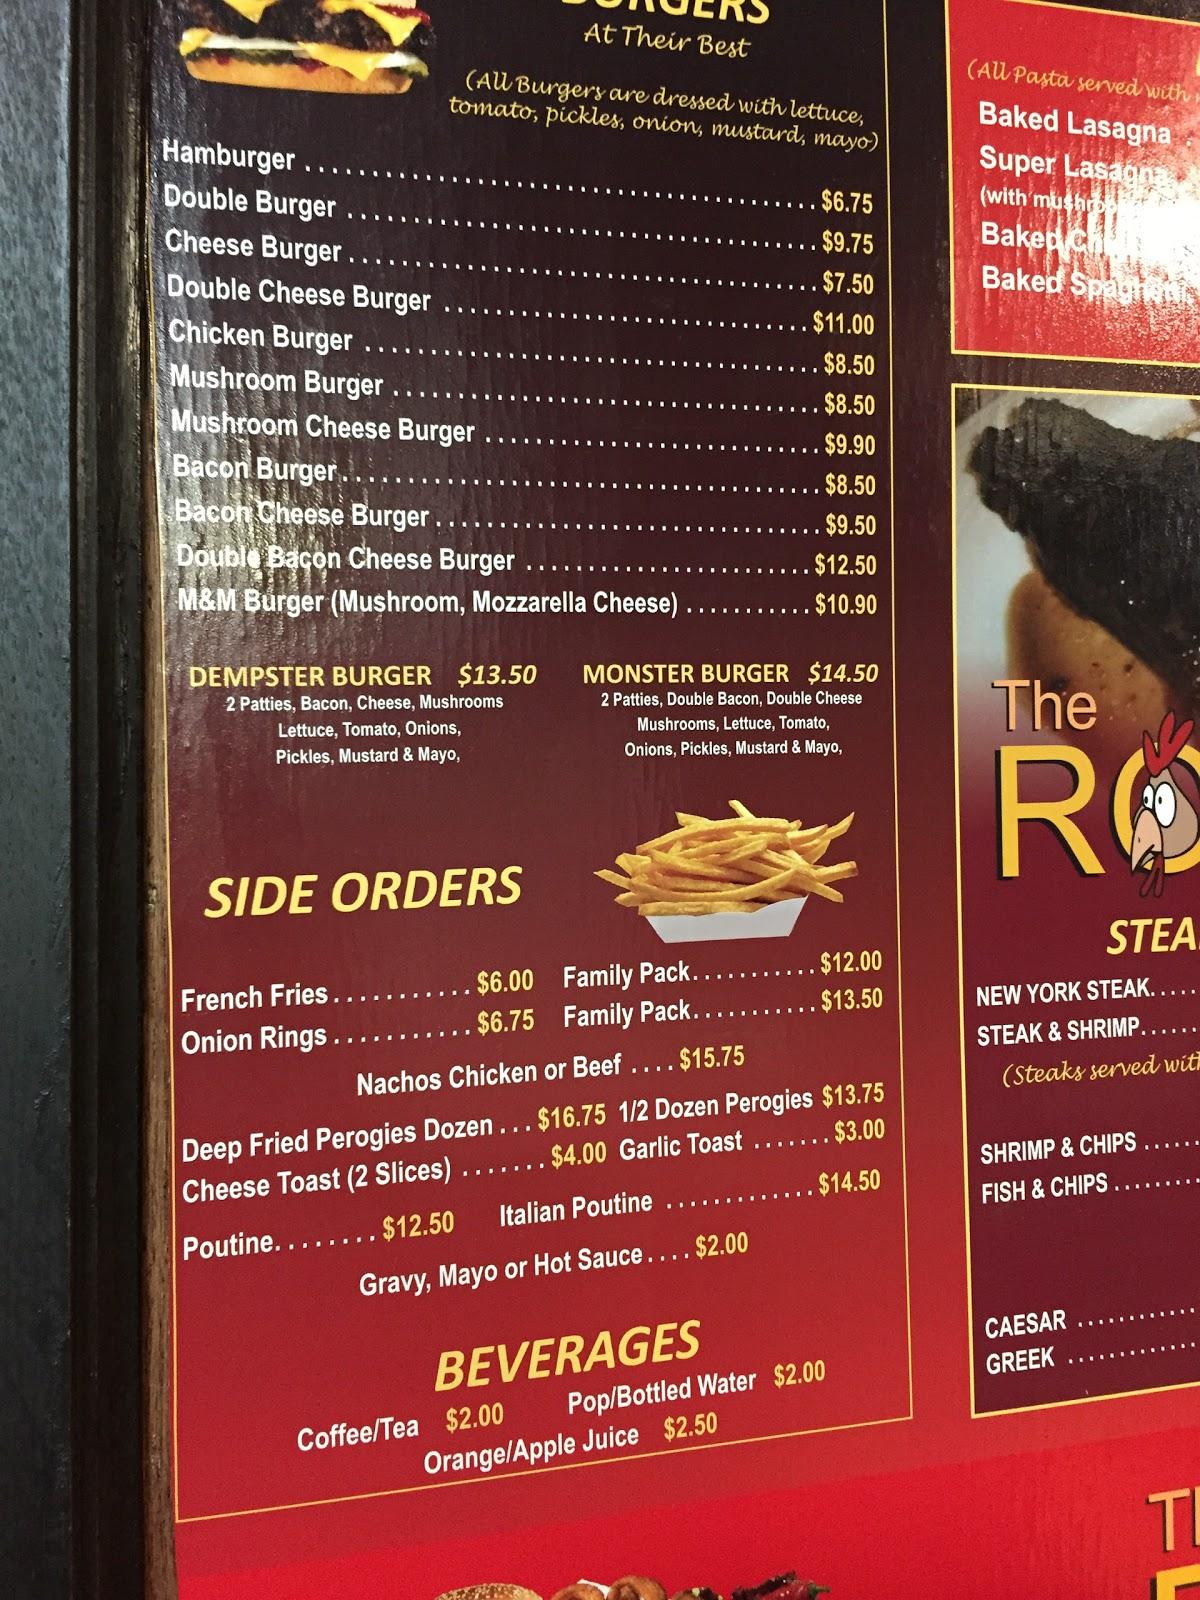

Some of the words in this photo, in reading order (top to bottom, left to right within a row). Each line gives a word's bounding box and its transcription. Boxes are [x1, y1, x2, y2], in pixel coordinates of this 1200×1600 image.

[622, 25, 691, 51] Their
[697, 35, 751, 58] Best
[466, 70, 512, 91] (All
[516, 76, 606, 102] Burgers
[653, 87, 735, 111] dressed
[791, 100, 863, 126] lettuce,
[968, 59, 1010, 80] (All
[1014, 66, 1074, 89] Pasta
[1078, 77, 1143, 96] served
[449, 96, 538, 122] tomato,
[546, 105, 624, 130] pickles,
[633, 116, 702, 137] onion,
[713, 124, 805, 145] mustard,
[815, 132, 878, 152] mayo)
[980, 101, 1058, 132] Baked
[1067, 110, 1172, 147] Lasagna
[163, 136, 295, 174] Hamburger
[822, 189, 872, 214] $6.75
[980, 145, 1056, 177] Super
[164, 182, 247, 213] Double
[256, 190, 336, 221] Burger
[823, 230, 873, 254] $9.75
[165, 227, 253, 256] Cheese
[262, 235, 342, 266] Burger
[823, 270, 873, 294] $7.50
[981, 265, 1062, 294] Baked
[168, 272, 250, 303] Double
[259, 279, 345, 306] Cheese
[353, 285, 431, 315] Burger
[814, 311, 874, 335] $11.00
[168, 316, 264, 353] Chicken
[273, 325, 352, 355] Burger
[824, 352, 874, 375] $8.50
[170, 363, 298, 394] Mushroom
[305, 370, 383, 400] Burger
[825, 392, 875, 415] $8.50
[171, 409, 300, 440] Mushroom
[306, 414, 390, 439] Cheese
[399, 418, 475, 447] Burger
[825, 432, 875, 456] $9.90
[172, 456, 251, 484] Bacon
[255, 457, 337, 490] Burger
[826, 473, 875, 496] $8.50
[175, 501, 253, 529] Bacon
[258, 501, 346, 529] Cheese
[352, 499, 429, 532] Burger
[826, 513, 876, 536] $9.50
[267, 545, 343, 572] Bacon
[348, 548, 434, 573] Cheese
[440, 548, 515, 576] Burger
[815, 553, 876, 576] $12.50
[177, 590, 238, 616] M&M
[243, 585, 324, 617] Burger
[332, 590, 464, 617] (Mushroom,
[473, 591, 586, 612] Mozzarella
[594, 591, 677, 618] Cheese)
[816, 593, 876, 616] $10.90
[189, 666, 324, 690] DEMPSTER
[333, 666, 431, 686] BURGER
[458, 663, 536, 688] $13.50
[584, 664, 694, 683] MONSTER
[702, 664, 789, 682] BURGER
[808, 662, 878, 685] $14.50
[240, 697, 295, 713] Patties,
[301, 696, 352, 712] Bacon,
[357, 695, 415, 711] Cheese,
[420, 694, 503, 708] Mushrooms
[614, 692, 662, 707] Patties,
[668, 692, 713, 705] Double
[718, 692, 762, 707] Bacon,
[767, 691, 812, 704] Double
[816, 691, 862, 704] Cheese
[992, 679, 1097, 731] The
[279, 723, 338, 739] Lettuce,
[342, 722, 400, 737] Tomato,
[406, 721, 461, 736] Onions,
[638, 717, 719, 732] Mushrooms,
[724, 717, 775, 731] Lettuce,
[779, 716, 829, 730] Tomato,
[277, 749, 334, 765] Pickles,
[339, 748, 398, 763] Mustard
[419, 747, 459, 764] Mayo,
[625, 742, 676, 757] Onions,
[681, 741, 731, 757] Pickles,
[736, 740, 787, 754] Mustard
[805, 740, 842, 756] Mayo,
[204, 875, 318, 918] SIDE
[332, 866, 522, 912] ORDERS
[182, 985, 262, 1012] French
[271, 983, 328, 1006] Fries
[478, 969, 533, 996] $6.00
[564, 964, 633, 990] Family
[821, 950, 881, 975] $12.00
[565, 1003, 633, 1029] Family
[822, 988, 882, 1013] $13.50
[977, 985, 1021, 1006] NEW
[1027, 982, 1081, 1003] YORK
[1087, 978, 1150, 1000] STEAK
[182, 1030, 252, 1054] Onion
[261, 1025, 326, 1052] Rings
[478, 1009, 534, 1036] $6.75
[978, 1023, 1043, 1046] STEAK
[1068, 1017, 1139, 1040] SHRIMP
[358, 1070, 441, 1095] Nachos
[449, 1063, 536, 1088] Chicken
[574, 1053, 621, 1077] Beef
[680, 1045, 744, 1072] $15.75
[1003, 1061, 1086, 1087] (Steaks
[1090, 1054, 1160, 1080] served
[619, 1100, 648, 1122] 1/2
[656, 1098, 718, 1119] Dozen
[726, 1089, 813, 1115] Perogies
[823, 1082, 884, 1108] $13.75
[183, 1139, 242, 1164] Deep
[250, 1129, 308, 1156] Fried
[317, 1123, 416, 1151] Perogies
[425, 1119, 492, 1140] Dozen
[538, 1104, 606, 1132] $16.75
[620, 1136, 680, 1160] Garlic
[687, 1131, 742, 1154] Toast
[835, 1119, 884, 1144] $3.00
[981, 1139, 1055, 1164] SHRIMP
[1080, 1132, 1136, 1155] CHIPS
[183, 1179, 269, 1203] Cheese
[277, 1168, 340, 1194] Toast
[376, 1156, 450, 1185] Slices)
[552, 1142, 606, 1169] $4.00
[983, 1180, 1025, 1203] FISH
[1051, 1173, 1107, 1197] CHIPS
[501, 1201, 564, 1226] Italian
[573, 1192, 652, 1218] Poutine
[819, 1169, 880, 1196] $14.50
[184, 1232, 273, 1260] Poutine
[383, 1211, 454, 1241] $12.50
[360, 1273, 430, 1296] Gravy,
[440, 1264, 497, 1289] Mayo
[535, 1252, 571, 1275] Hot
[578, 1248, 642, 1270] Sauce
[696, 1232, 748, 1259] $2.00
[986, 1310, 1066, 1338] CAESAR
[434, 1318, 701, 1394] BEVERAGES
[987, 1346, 1054, 1374] GREEK
[569, 1377, 691, 1416] Pop/Bottled
[697, 1372, 756, 1396] Water
[774, 1360, 825, 1388] $2.00
[298, 1417, 418, 1451] Coffee/Tea
[447, 1403, 503, 1433] $2.00
[422, 1432, 577, 1476] Orange/Apple
[583, 1426, 638, 1451] Juice
[664, 1412, 717, 1441] $2.50
